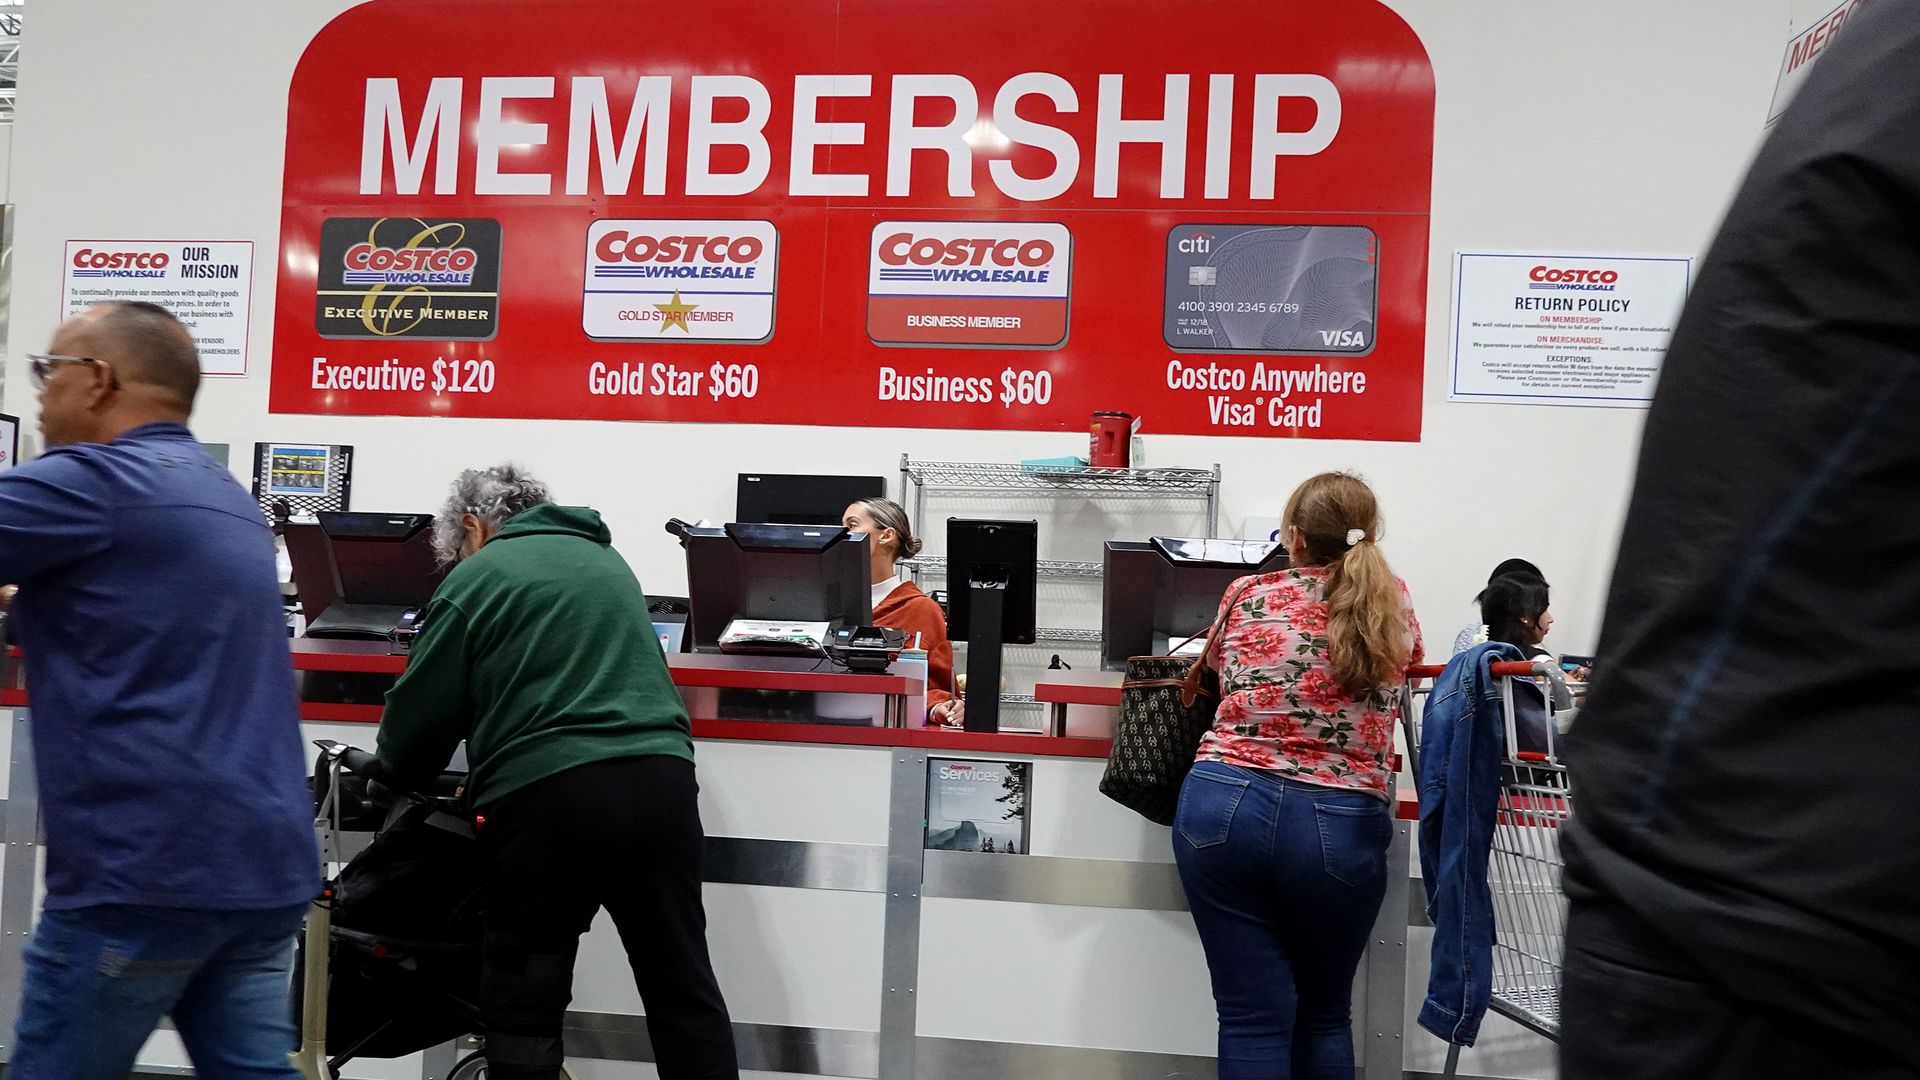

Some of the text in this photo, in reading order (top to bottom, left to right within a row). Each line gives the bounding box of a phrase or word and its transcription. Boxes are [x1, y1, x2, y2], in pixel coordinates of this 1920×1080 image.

[1787, 0, 1858, 74] MER
[360, 72, 1342, 201] MEMBERSHIP
[595, 230, 763, 264] COSTCO
[878, 232, 1055, 267] COSTCO
[1178, 236, 1210, 253] citi
[74, 248, 170, 268] COSTCO
[182, 247, 210, 262] OUR
[346, 244, 476, 271] COSTCO
[181, 264, 238, 279] MISSION
[384, 272, 471, 284] WHOLESALE
[644, 266, 756, 279] WHOLESALE
[932, 268, 1050, 283] WHOLESALE
[1529, 266, 1618, 284] COSTCO
[79, 288, 113, 298] continually
[115, 288, 138, 298] provide
[196, 290, 219, 298] quality
[220, 290, 239, 298] goods
[1556, 284, 1616, 292] WHOLESALE
[176, 300, 196, 308] prices.
[1178, 301, 1299, 313] 4100 3901 2345 6789
[1514, 296, 1631, 313] RETURN POLICY
[324, 306, 489, 320] EXECUTIVE MEMBER
[618, 310, 734, 322] GOLD STAR MEMBER
[907, 315, 1021, 329] BUSINESS MEMBER
[1319, 330, 1365, 347] VISA
[312, 356, 495, 396] Executive $120
[589, 361, 758, 402] Gold Star $60
[1166, 360, 1366, 398] Costco Anywhere
[878, 366, 1052, 408] Business $60
[1268, 397, 1322, 428] Card
[940, 767, 1000, 782] Services
